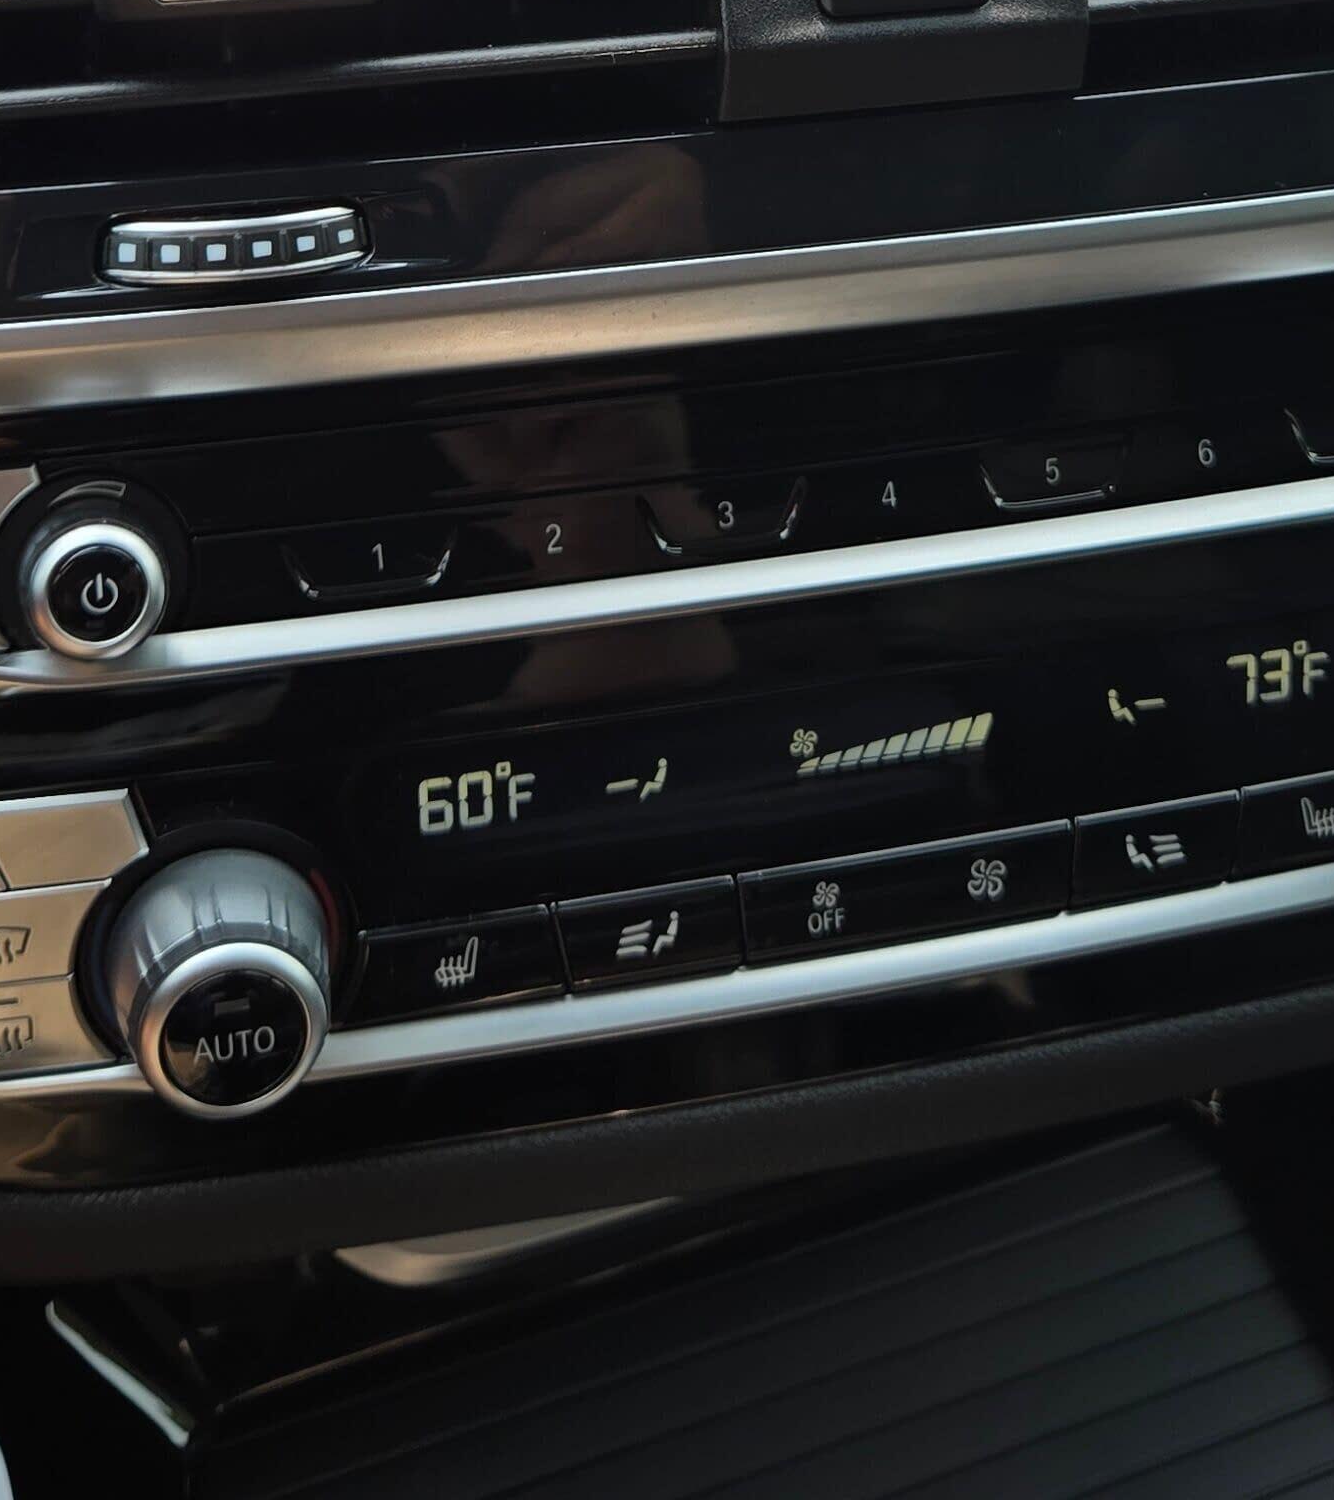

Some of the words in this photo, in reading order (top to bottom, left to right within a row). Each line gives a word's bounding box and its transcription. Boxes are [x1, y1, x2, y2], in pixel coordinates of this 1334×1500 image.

[1197, 438, 1215, 468] 6
[1045, 457, 1061, 486] 5
[880, 480, 898, 507] 4
[716, 501, 735, 529] 3
[545, 524, 564, 555] 2
[371, 542, 385, 572] 1
[808, 906, 845, 937] OFF
[193, 1024, 277, 1066] AUTO
